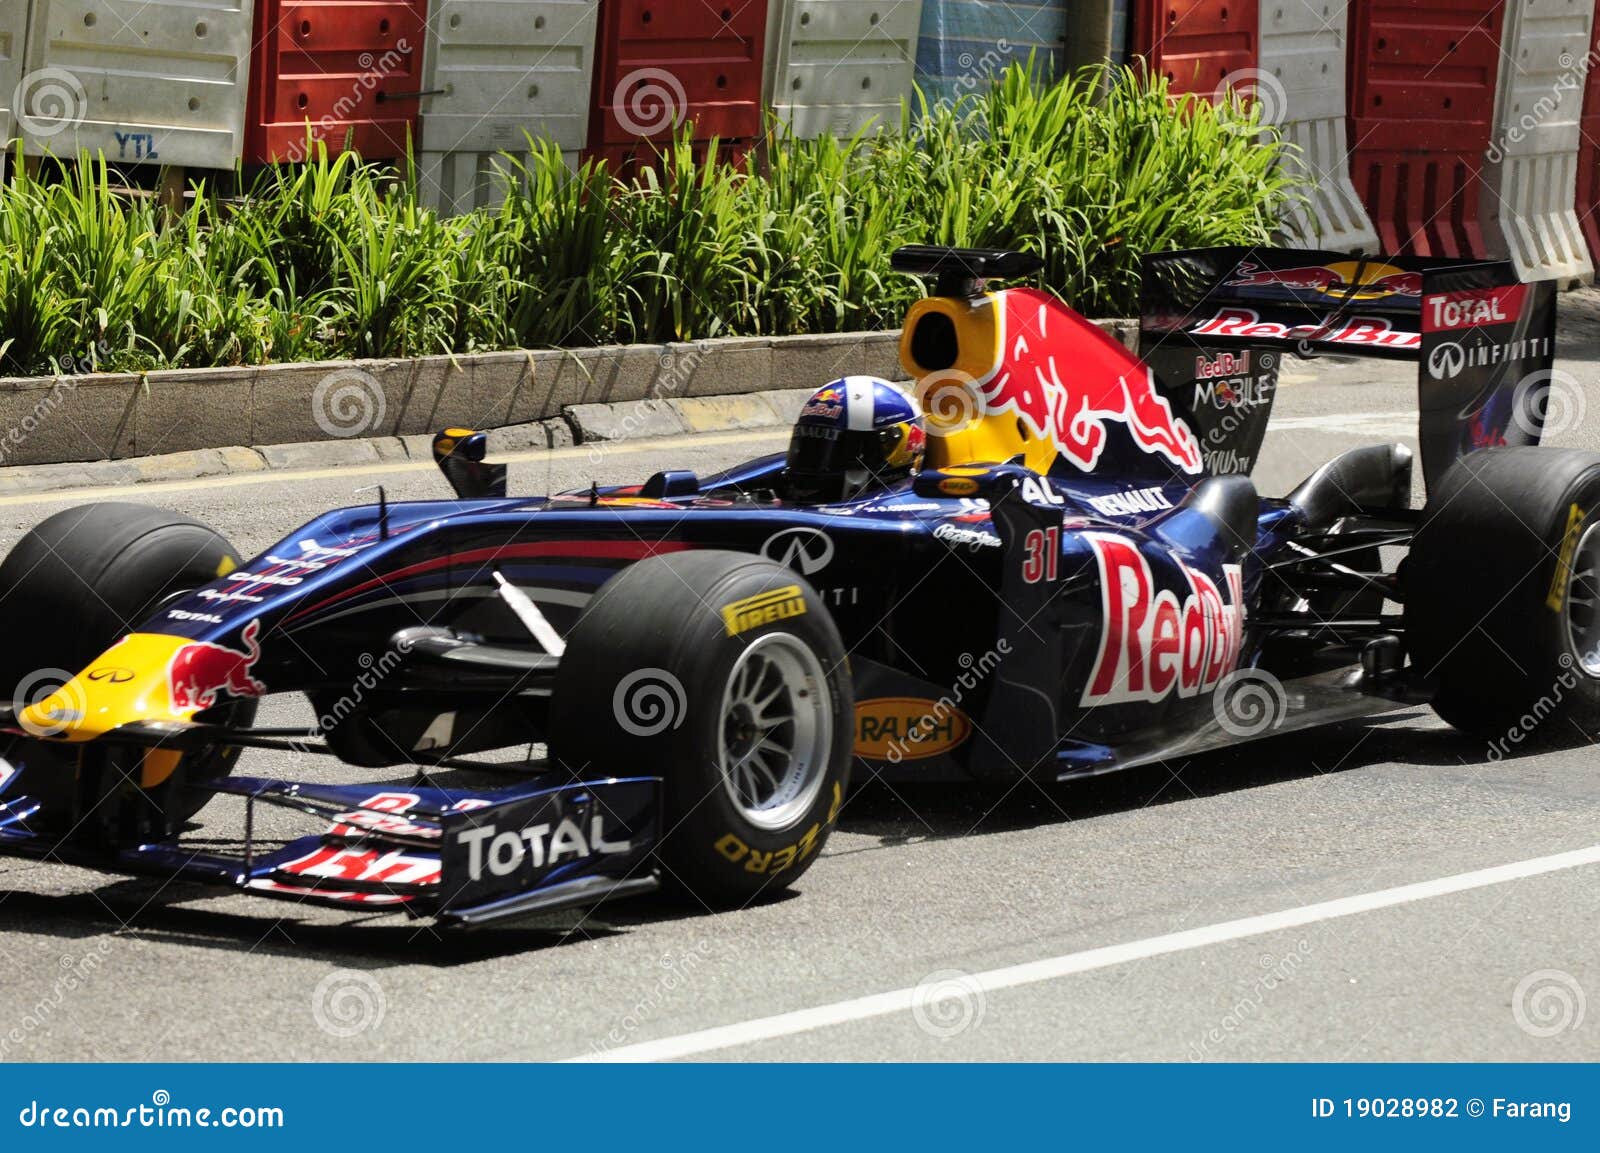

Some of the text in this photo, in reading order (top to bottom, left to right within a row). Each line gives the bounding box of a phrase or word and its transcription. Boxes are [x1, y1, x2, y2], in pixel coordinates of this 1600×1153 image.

[114, 131, 159, 160] YTL
[1429, 297, 1506, 328] TOTAL
[1468, 337, 1549, 368] INFINITI
[1087, 486, 1174, 517] RENAULT
[1022, 526, 1059, 584] 31
[167, 609, 224, 624] TOTAL
[721, 585, 808, 638] PIRELLI
[457, 815, 631, 881] TOTAL
[714, 822, 822, 876] ZERO
